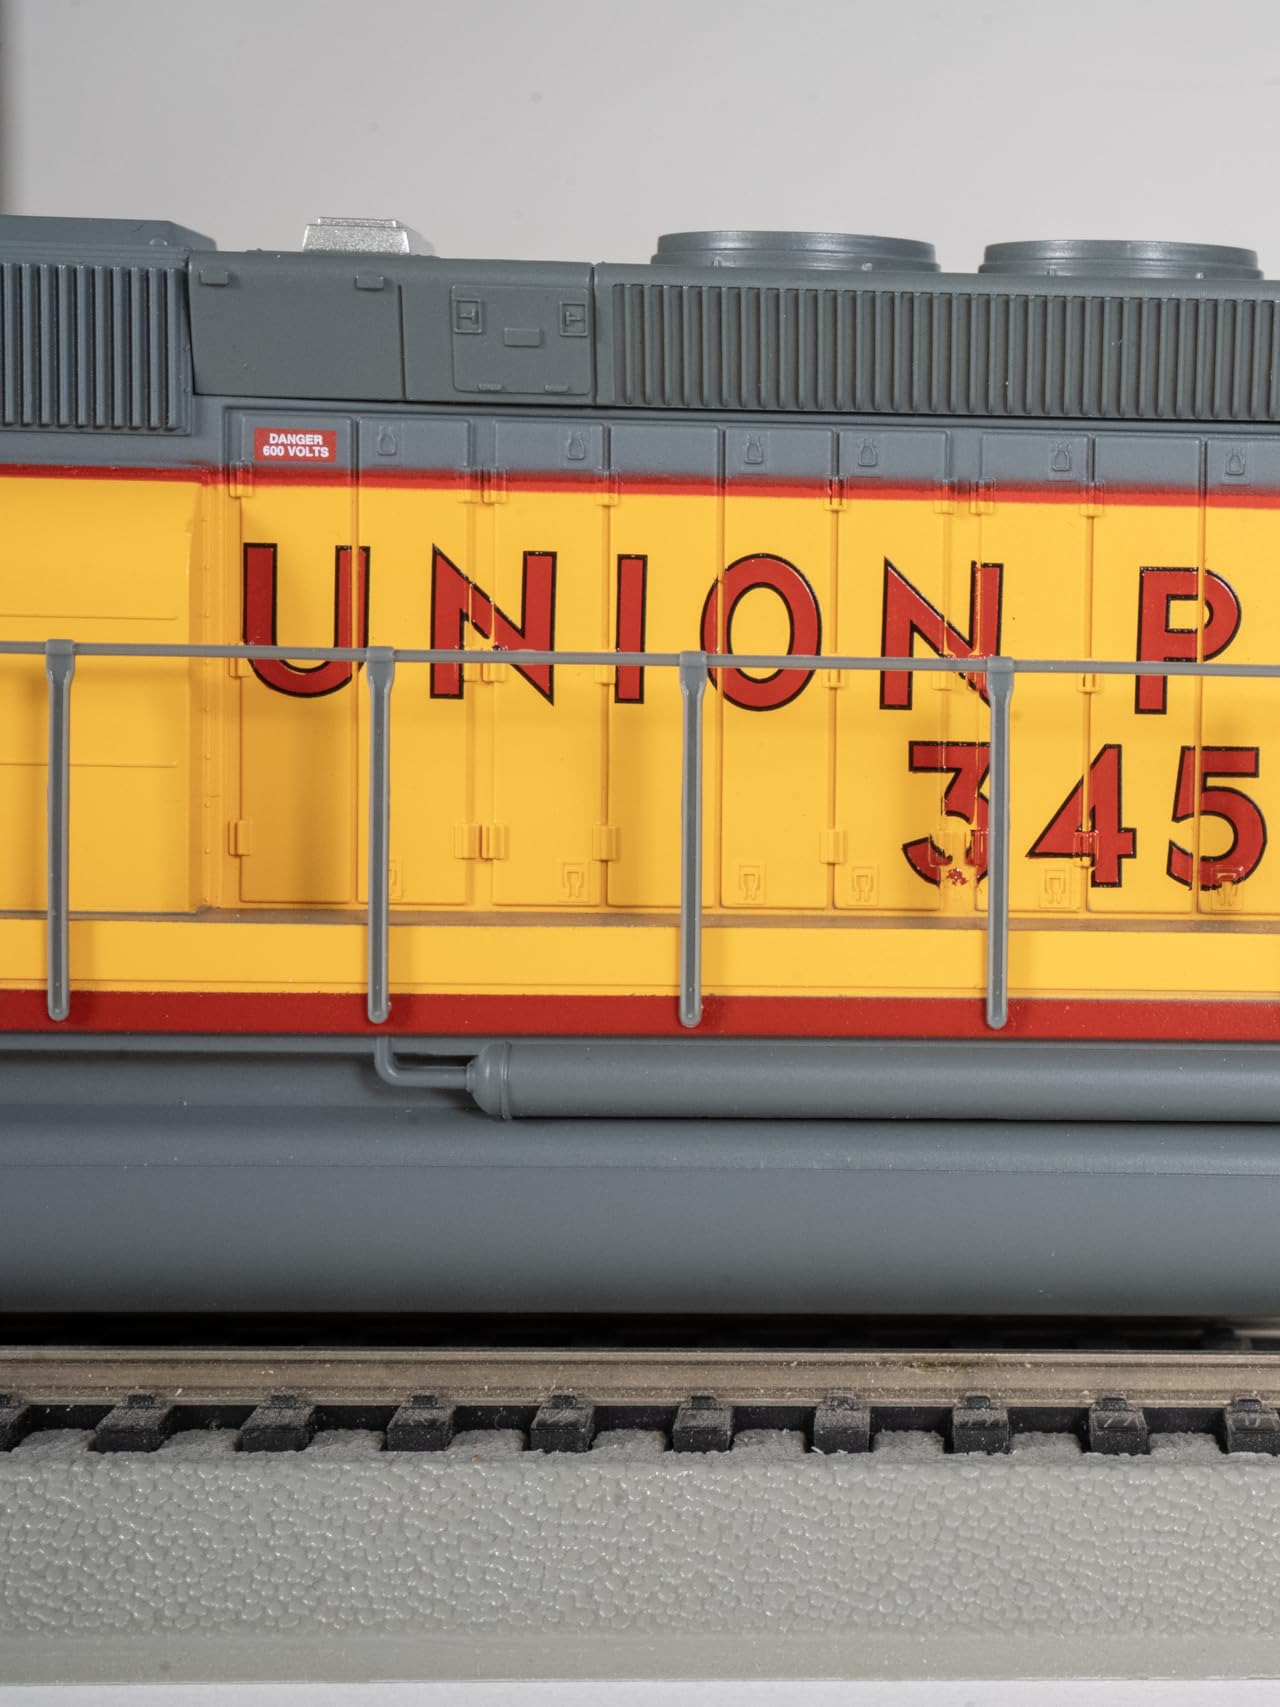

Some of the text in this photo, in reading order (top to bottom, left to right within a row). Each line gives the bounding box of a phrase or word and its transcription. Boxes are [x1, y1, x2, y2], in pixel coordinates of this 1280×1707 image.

[269, 432, 324, 446] DANGER
[262, 445, 330, 458] 600 VOLTS
[243, 542, 1004, 711] UNION
